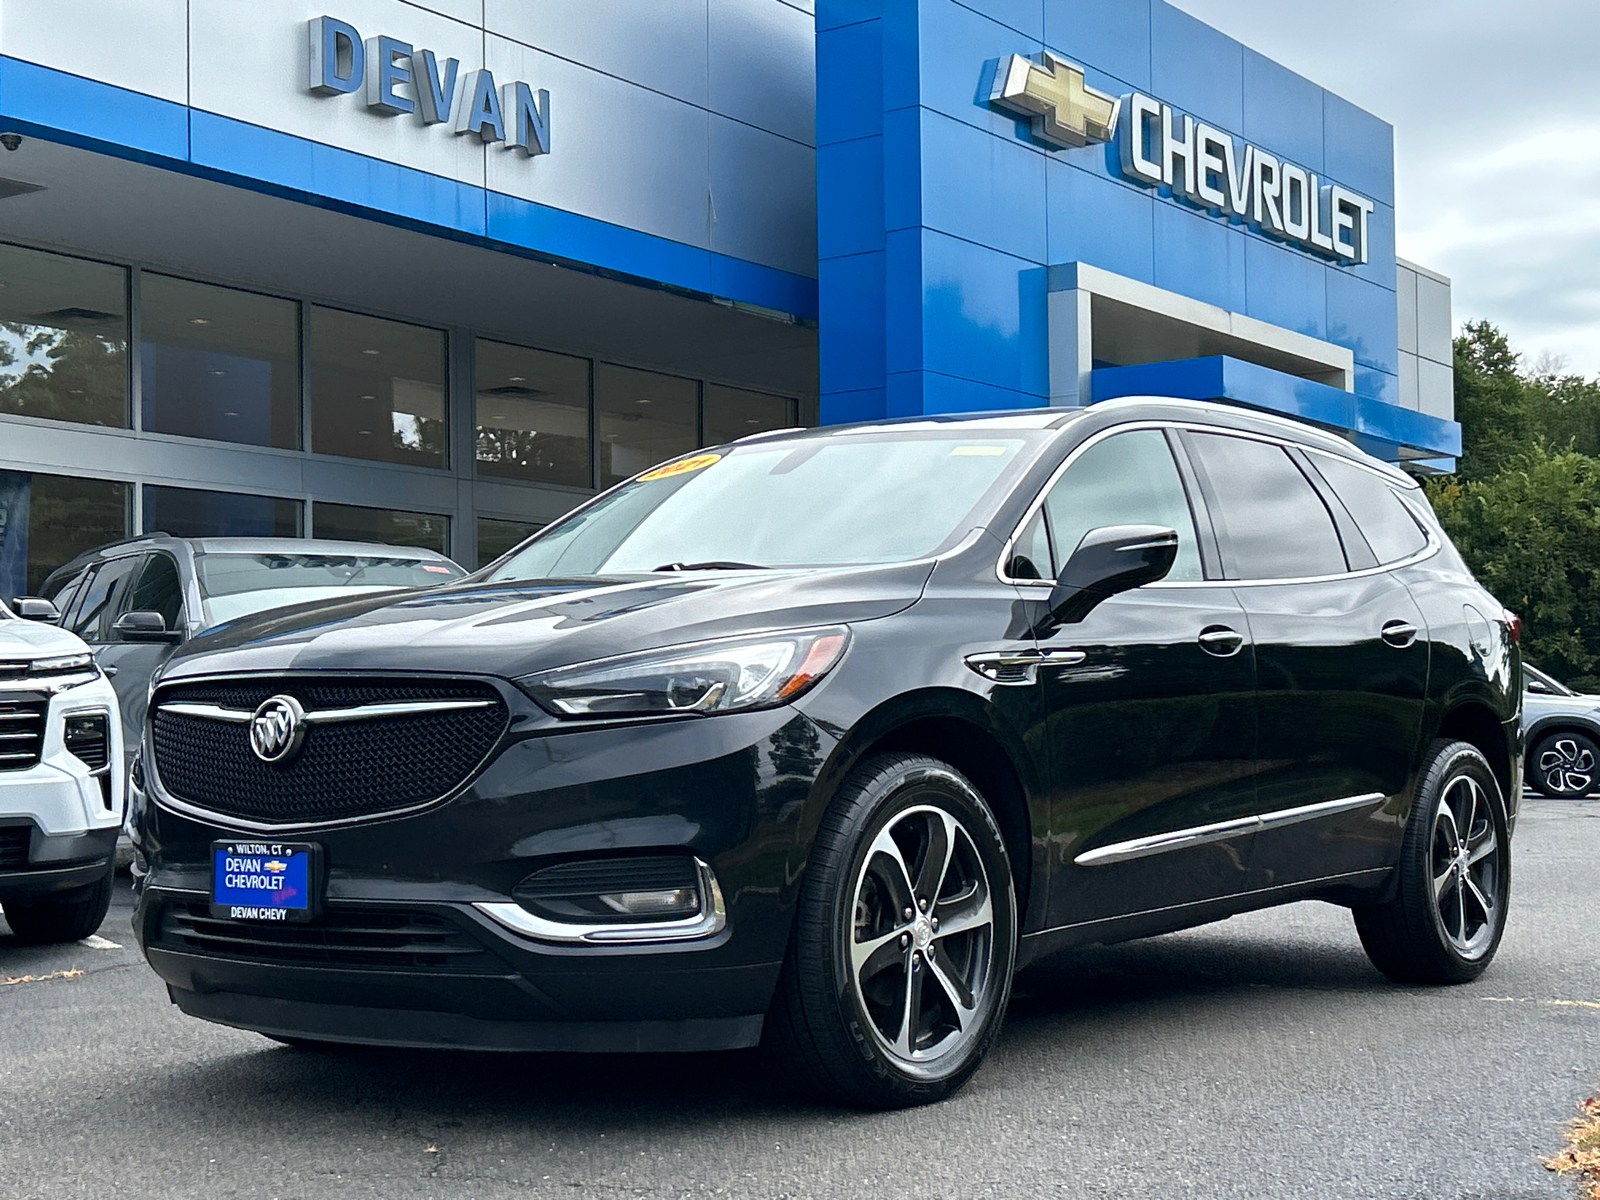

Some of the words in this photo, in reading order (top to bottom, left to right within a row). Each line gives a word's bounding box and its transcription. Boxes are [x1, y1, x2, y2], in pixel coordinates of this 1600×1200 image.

[309, 15, 551, 156] DEVAN
[1131, 92, 1374, 265] CHEVROLET
[236, 844, 270, 855] WILTON,
[271, 845, 283, 856] CT
[225, 858, 261, 873] DEVAN
[225, 874, 286, 890] CHEVROLET
[231, 907, 258, 919] DEVAN
[259, 908, 287, 920] CHEVY
